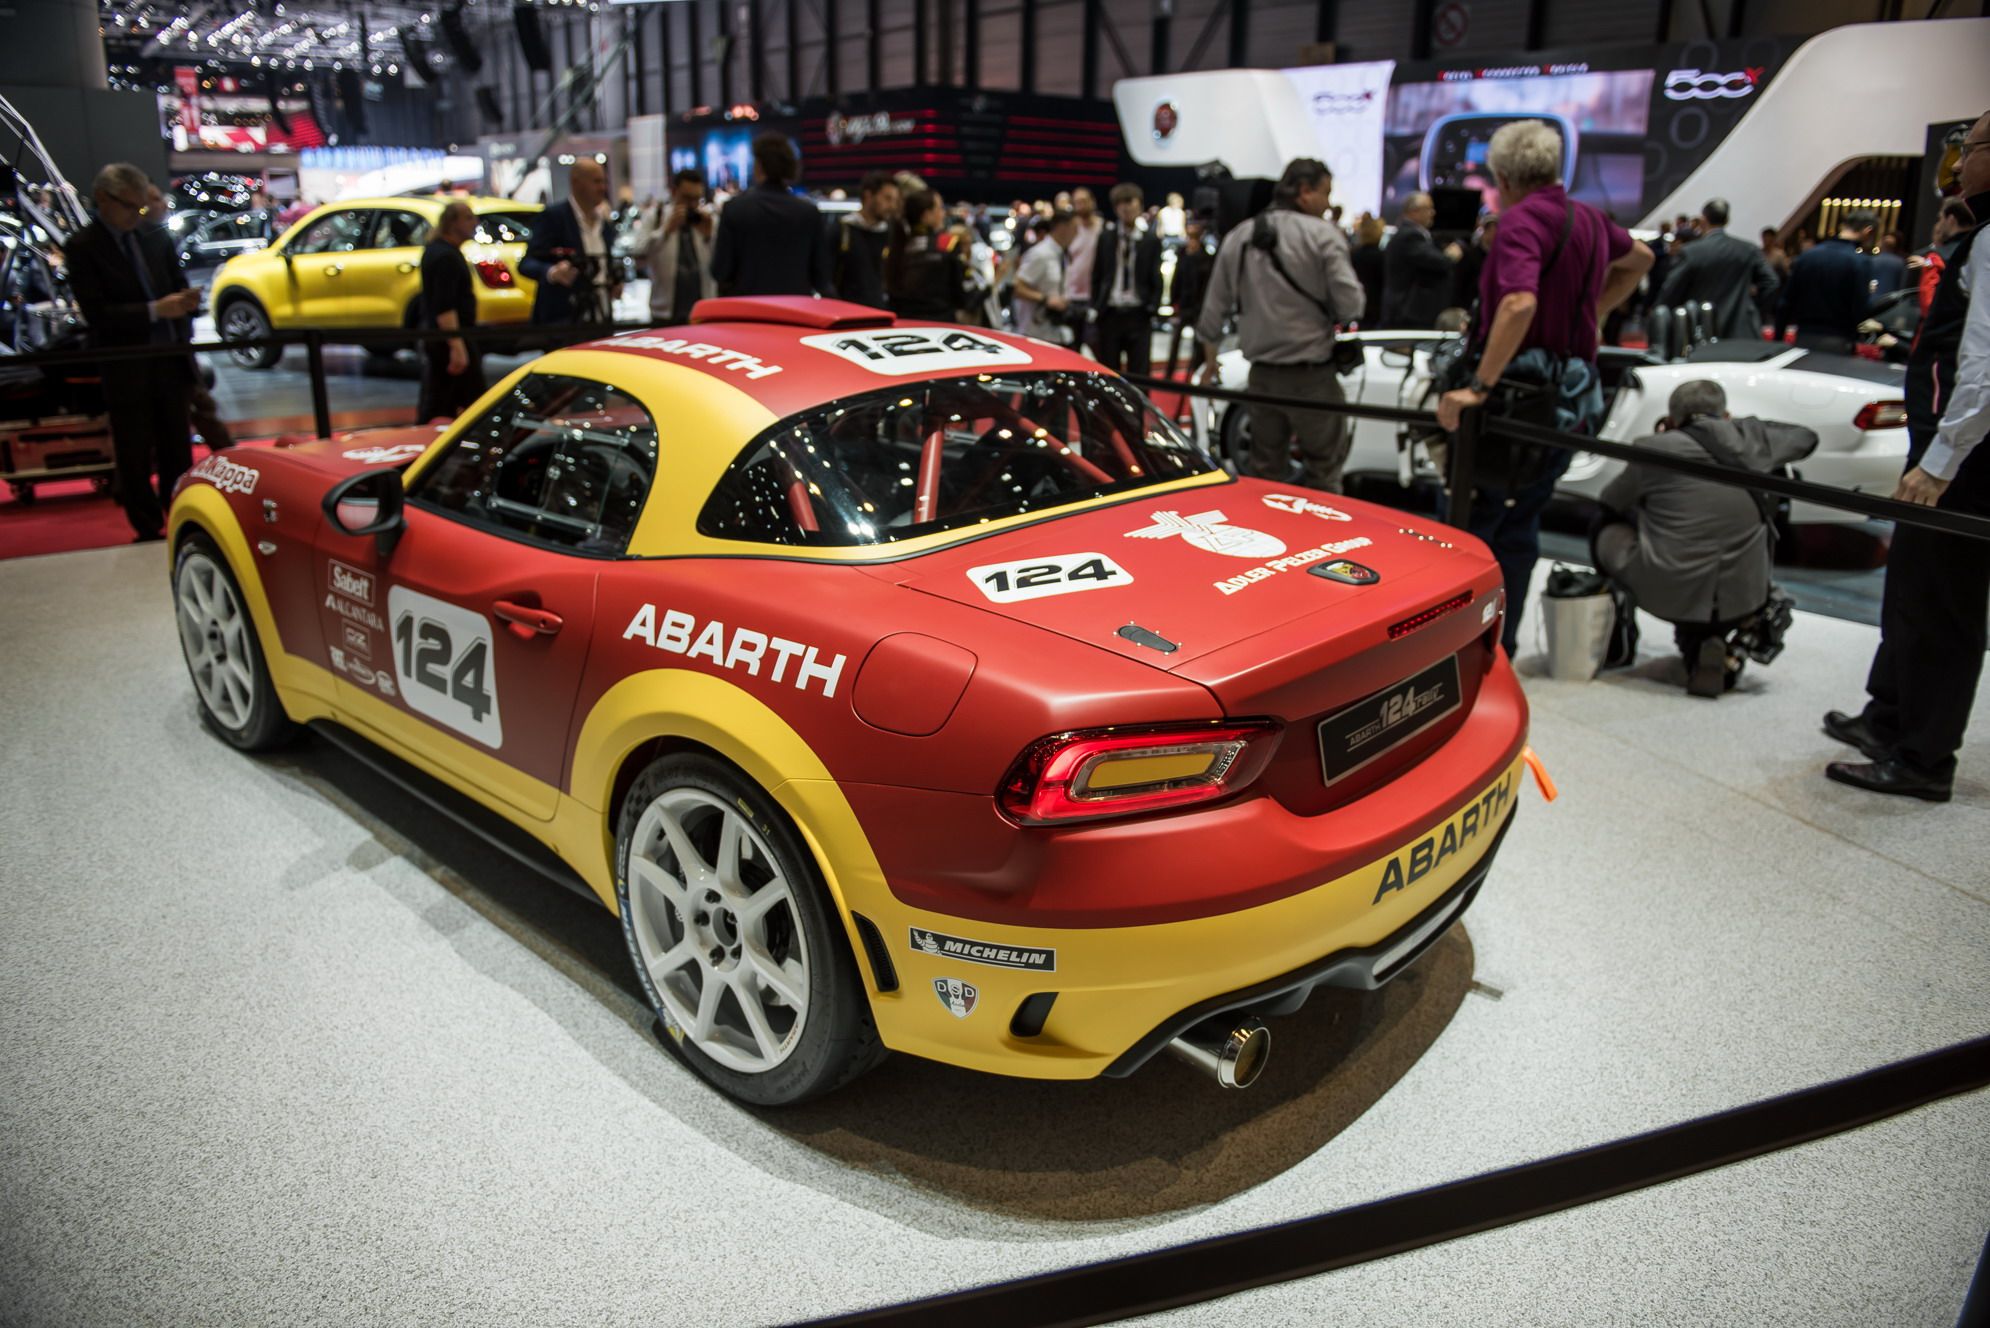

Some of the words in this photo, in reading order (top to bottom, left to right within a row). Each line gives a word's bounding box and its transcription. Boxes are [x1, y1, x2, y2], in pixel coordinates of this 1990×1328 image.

[590, 335, 783, 380] ABARTH
[836, 333, 1003, 361] 124
[208, 456, 260, 495] Kappa
[984, 558, 1117, 592] 124
[395, 609, 492, 723] 124
[622, 603, 847, 698] ABARTH
[1349, 723, 1381, 746] ABARTH
[1380, 686, 1416, 728] 124
[1371, 771, 1512, 906] ABARTH
[943, 940, 1047, 965] MICHELIN
